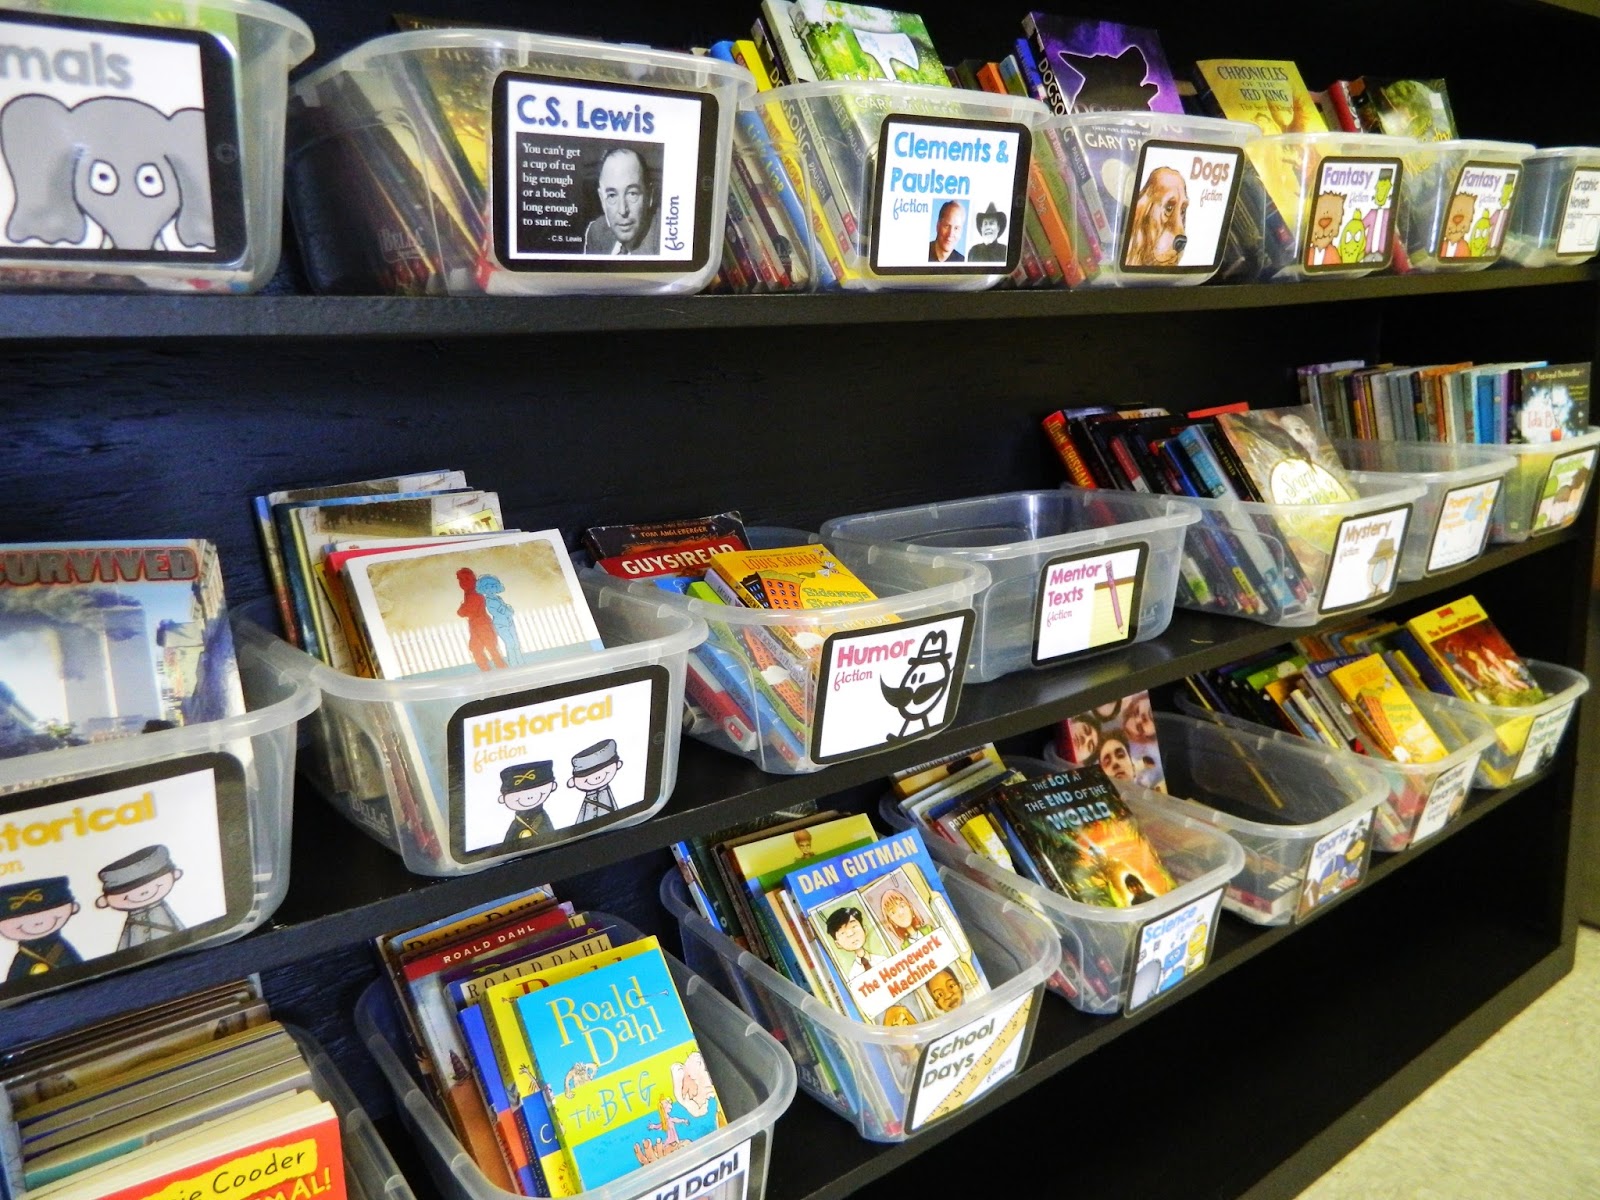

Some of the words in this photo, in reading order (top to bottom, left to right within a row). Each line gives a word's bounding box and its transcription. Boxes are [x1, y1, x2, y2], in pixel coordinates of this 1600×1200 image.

[1217, 66, 1289, 81] CHRONICLES
[1240, 88, 1261, 101] RED
[1262, 89, 1289, 102] KING
[517, 94, 568, 127] C.S.
[576, 100, 655, 134] Lewis
[522, 143, 541, 154] You
[543, 144, 565, 156] can't
[566, 148, 581, 158] get
[893, 131, 991, 163] Clements
[995, 140, 1010, 165] &
[1084, 132, 1124, 151] GARY
[522, 173, 537, 185] big
[539, 175, 573, 186] enough
[530, 161, 548, 171] cup
[549, 160, 560, 170] of
[561, 162, 576, 171] tea
[1189, 156, 1230, 184] Dogs
[1323, 166, 1374, 190] Fantasy
[522, 189, 533, 198] or
[535, 190, 541, 198] a
[542, 189, 567, 199] book
[890, 167, 971, 196] Paulsen
[1460, 170, 1502, 192] Fantasy
[522, 202, 544, 215] long
[544, 203, 578, 216] enough
[522, 217, 533, 226] to
[535, 217, 552, 227] suit
[554, 218, 572, 228] me.
[665, 195, 685, 251] fiction
[893, 198, 929, 221] fiction
[1342, 520, 1393, 545] Mystery
[0, 546, 199, 588] URVIVED
[741, 556, 777, 571] LOUIS
[778, 553, 823, 569] SACHAR
[1049, 563, 1103, 586] Mentor
[1047, 586, 1084, 607] Texts
[1046, 609, 1073, 628] fiction
[837, 638, 916, 669] Humor
[833, 669, 873, 692] fiction
[472, 694, 614, 748] Historical
[473, 744, 528, 775] fiction
[1032, 781, 1049, 791] THE
[1047, 773, 1071, 787] BOY
[1073, 773, 1082, 782] AT
[1024, 799, 1047, 813] THE
[1044, 790, 1074, 807] END
[1074, 788, 1088, 800] OF
[1088, 784, 1108, 798] THE
[0, 791, 158, 852] torical
[1046, 801, 1112, 831] WORLD
[797, 864, 841, 895] DAN
[841, 835, 920, 879] GUTMAN
[1143, 906, 1198, 944] Science
[443, 941, 491, 964] ROALD
[497, 924, 536, 943] DAHL
[466, 962, 544, 999] ROALD
[551, 939, 610, 966] DAHL
[857, 977, 881, 999] The
[878, 935, 943, 984] Homework
[886, 957, 939, 999] Machine
[545, 975, 651, 1048] Roald
[581, 1005, 666, 1068] Dahl
[928, 1017, 996, 1066] School
[922, 1052, 975, 1089] Days
[570, 1104, 602, 1129] The
[598, 1070, 657, 1127] BFG
[212, 1150, 306, 1194] Cooder
[685, 1151, 739, 1198] Dahl
